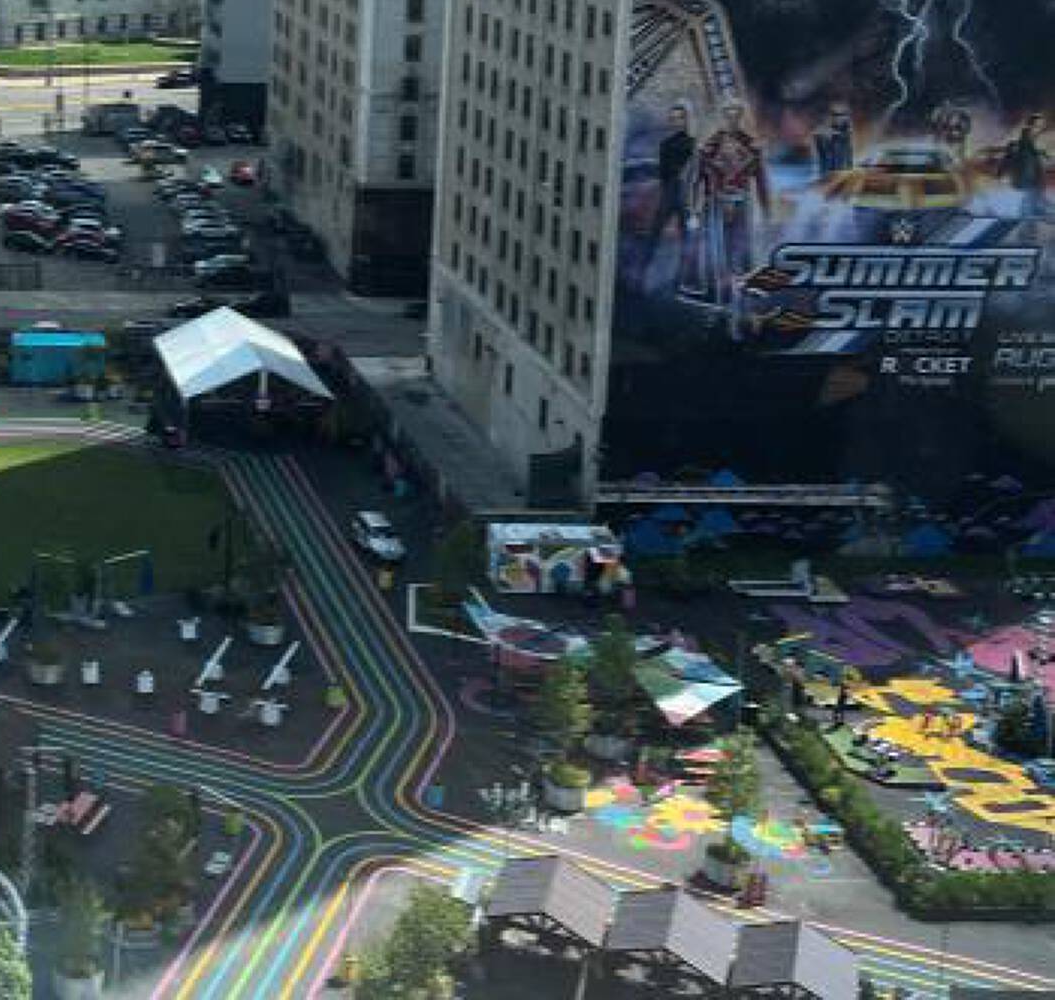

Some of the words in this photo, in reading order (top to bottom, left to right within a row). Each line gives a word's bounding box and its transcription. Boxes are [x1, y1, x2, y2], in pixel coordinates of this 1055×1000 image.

[778, 246, 1038, 286] SUMMER
[812, 290, 986, 329] SLAM
[880, 356, 974, 373] RCKET
